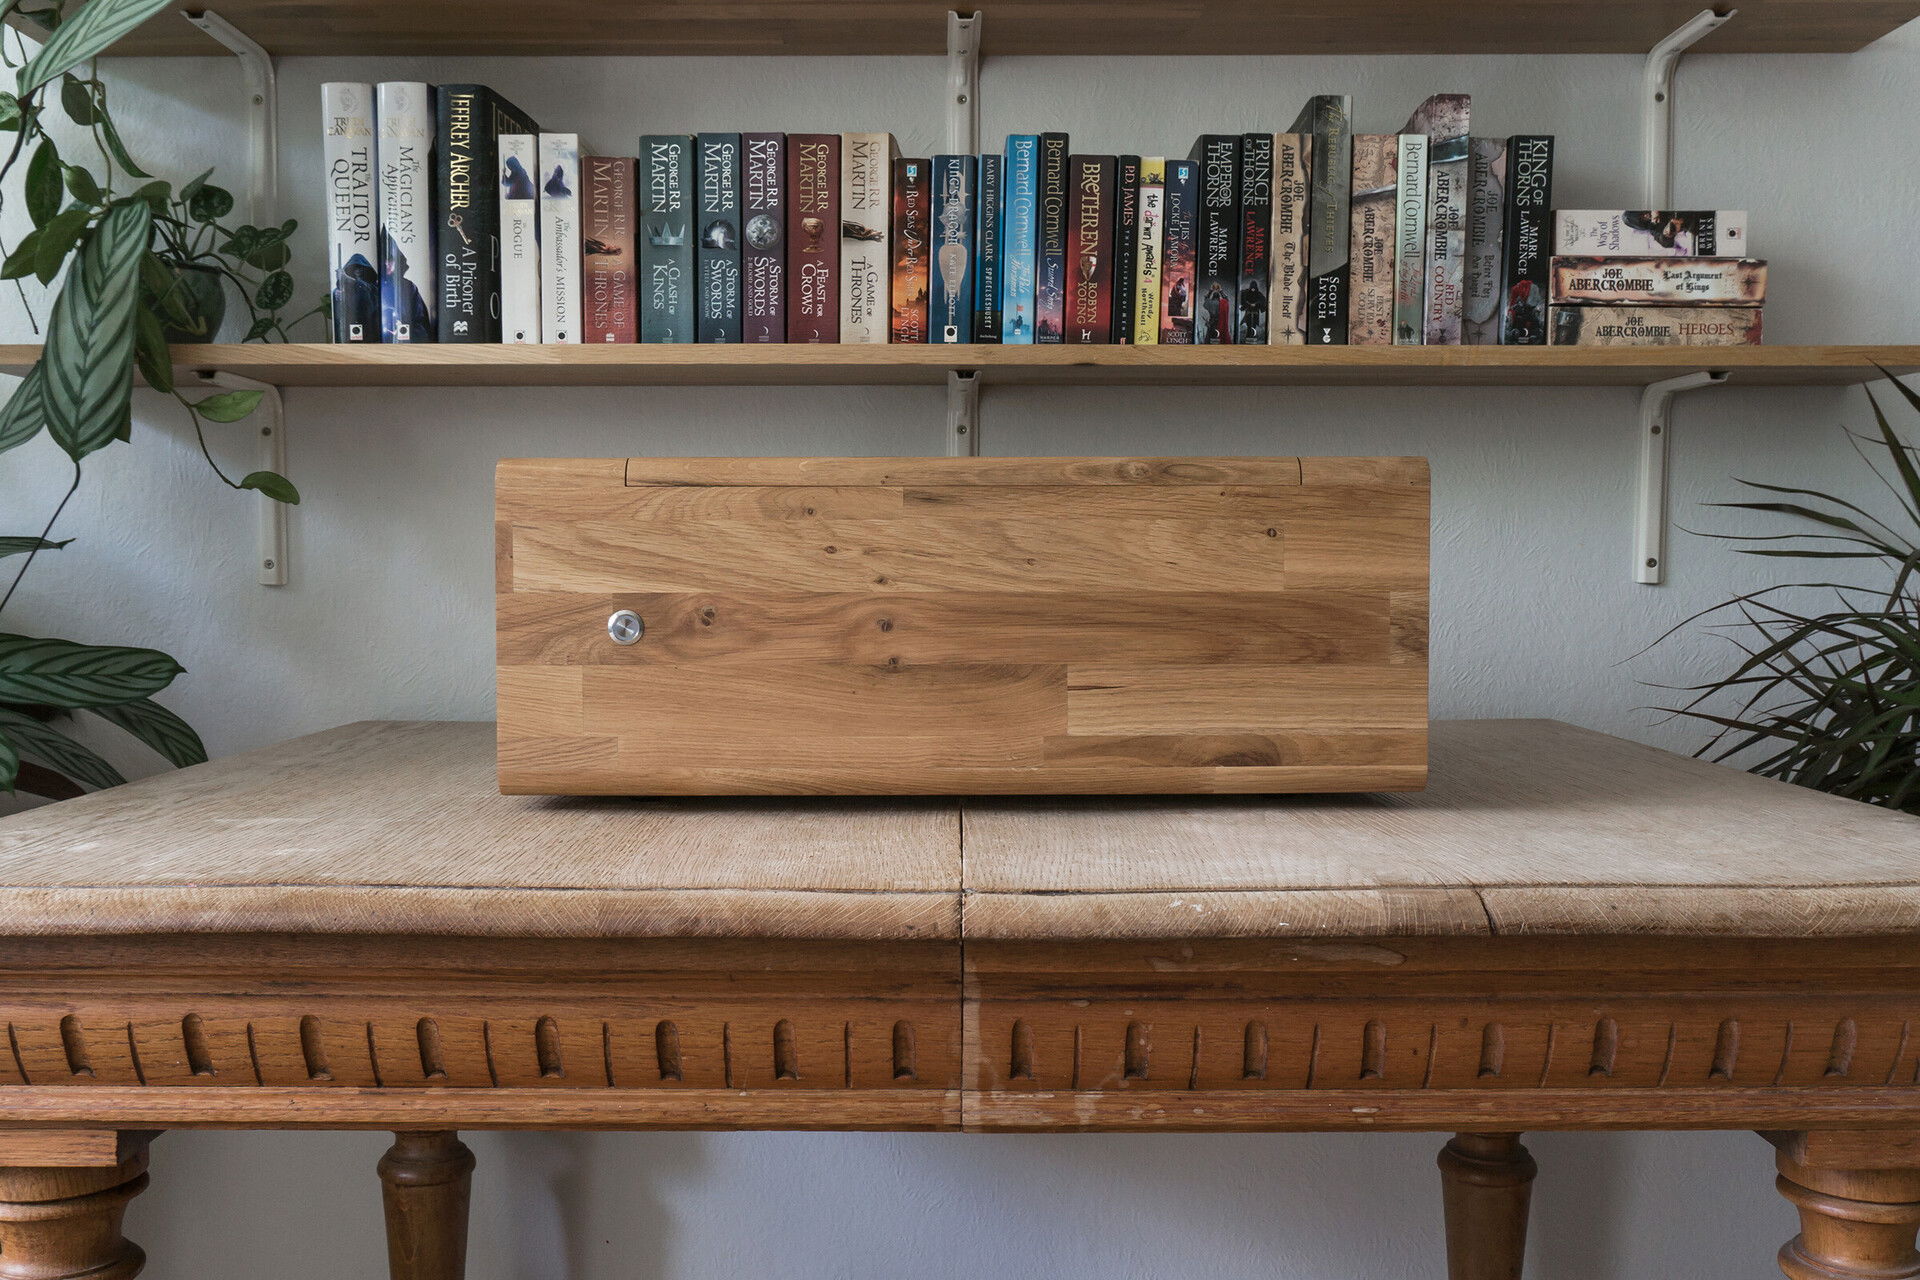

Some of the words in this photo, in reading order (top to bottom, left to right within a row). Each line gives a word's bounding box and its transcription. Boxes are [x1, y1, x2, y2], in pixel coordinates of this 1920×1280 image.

[448, 91, 475, 150] JEFFREY
[449, 151, 475, 211] ARCHER
[613, 160, 625, 208] GEORGE
[651, 142, 669, 214] MARTIN
[668, 143, 680, 189] GEORGE
[704, 142, 721, 213] MARTIN
[722, 143, 734, 189] GEORGE
[749, 140, 766, 210] MARTIN
[766, 140, 779, 186] GEORGE
[799, 143, 817, 213] MARTIN
[817, 144, 829, 189] GEORGE
[852, 140, 869, 210] MARTIN
[869, 141, 881, 188] GEORGE
[986, 159, 994, 187] MARY
[1015, 140, 1033, 195] Bernard
[1046, 140, 1064, 195] Bernard
[1125, 165, 1136, 184] P.D.
[1206, 142, 1220, 207] THORNS
[1219, 142, 1233, 208] EMPEROR
[1243, 149, 1255, 206] THORNS
[1254, 139, 1270, 206] PRINCE
[1405, 143, 1422, 197] Bernard
[1516, 139, 1532, 206] THORNS
[1531, 139, 1549, 187] KING
[331, 159, 351, 233] QUEEN
[351, 146, 370, 244] TRAITOR
[382, 164, 399, 233] Apprentice
[399, 146, 416, 244] MAGICIAN'S
[593, 161, 612, 240] MARTIN
[985, 189, 994, 228] HIGGINS
[1122, 187, 1135, 226] JAMES
[1147, 193, 1158, 208] the
[1170, 192, 1181, 225] LOCKE
[1280, 144, 1295, 235] ABERCROMBIE
[1293, 180, 1305, 202] JOE
[1471, 152, 1488, 248] ABERCROMBIE
[1486, 190, 1498, 214] JOE
[1533, 189, 1543, 206] OF
[1013, 197, 1032, 256] Cornwell
[1044, 197, 1062, 256] Cornwell
[1325, 202, 1338, 254] THIEVES
[1403, 199, 1421, 258] Cornwell
[1434, 170, 1450, 261] ABERCROMBIE
[1447, 206, 1459, 230] JOE
[1608, 215, 1620, 250] Shadows
[462, 246, 477, 257] A
[513, 219, 523, 259] ROGUE
[985, 230, 993, 261] CLARK
[1169, 228, 1180, 268] LAMORA
[1208, 211, 1219, 276] LAWRENCE
[1218, 227, 1228, 260] MARK
[1245, 211, 1256, 275] LAWRENCE
[1254, 227, 1265, 259] MARK
[1283, 242, 1296, 261] The
[1362, 206, 1375, 283] ABERCROMBIE
[1374, 236, 1384, 255] JOE
[1518, 210, 1530, 275] LAWRENCE
[1528, 226, 1539, 259] MARK
[445, 253, 461, 271] of
[1046, 257, 1059, 290] Sword
[1283, 263, 1295, 292] Blade
[1602, 268, 1624, 278] JOE
[1663, 270, 1683, 280] Last
[1683, 270, 1723, 281] Argument
[446, 274, 461, 308] Birth
[462, 262, 477, 315] Prisoner
[556, 275, 566, 323] MISSION
[594, 262, 609, 329] THRONES
[613, 270, 626, 308] GAME
[653, 264, 668, 310] KINGS
[668, 267, 681, 304] CLASH
[710, 260, 726, 319] SWORDS
[726, 268, 738, 308] STORM
[754, 257, 769, 317] SWORDS
[769, 265, 781, 305] STORM
[801, 263, 816, 315] CROWS
[817, 268, 829, 303] FEAST
[851, 256, 866, 324] THRONES
[866, 271, 878, 307] GAME
[1046, 288, 1058, 310] Song
[1076, 280, 1088, 325] YOUNG
[1087, 282, 1098, 324] ROBYN
[1147, 292, 1155, 319] Wendy
[1318, 277, 1330, 319] LYNCH
[1328, 276, 1340, 316] SCOTT
[1366, 288, 1375, 325] SERVED
[1376, 295, 1384, 317] BEST
[1433, 265, 1445, 322] COUNTRY
[1444, 284, 1455, 305] RED
[1569, 279, 1654, 292] ABERCROMBIE
[1675, 283, 1684, 291] of
[1685, 283, 1710, 293] Kings
[613, 312, 625, 328] OF
[901, 307, 910, 342] LYNCH
[910, 309, 919, 341] SCOTT
[1358, 292, 1366, 322] COLD
[1625, 316, 1644, 326] JOE
[1595, 326, 1671, 338] ABERCROMBIE
[1679, 323, 1735, 336] HEROES
